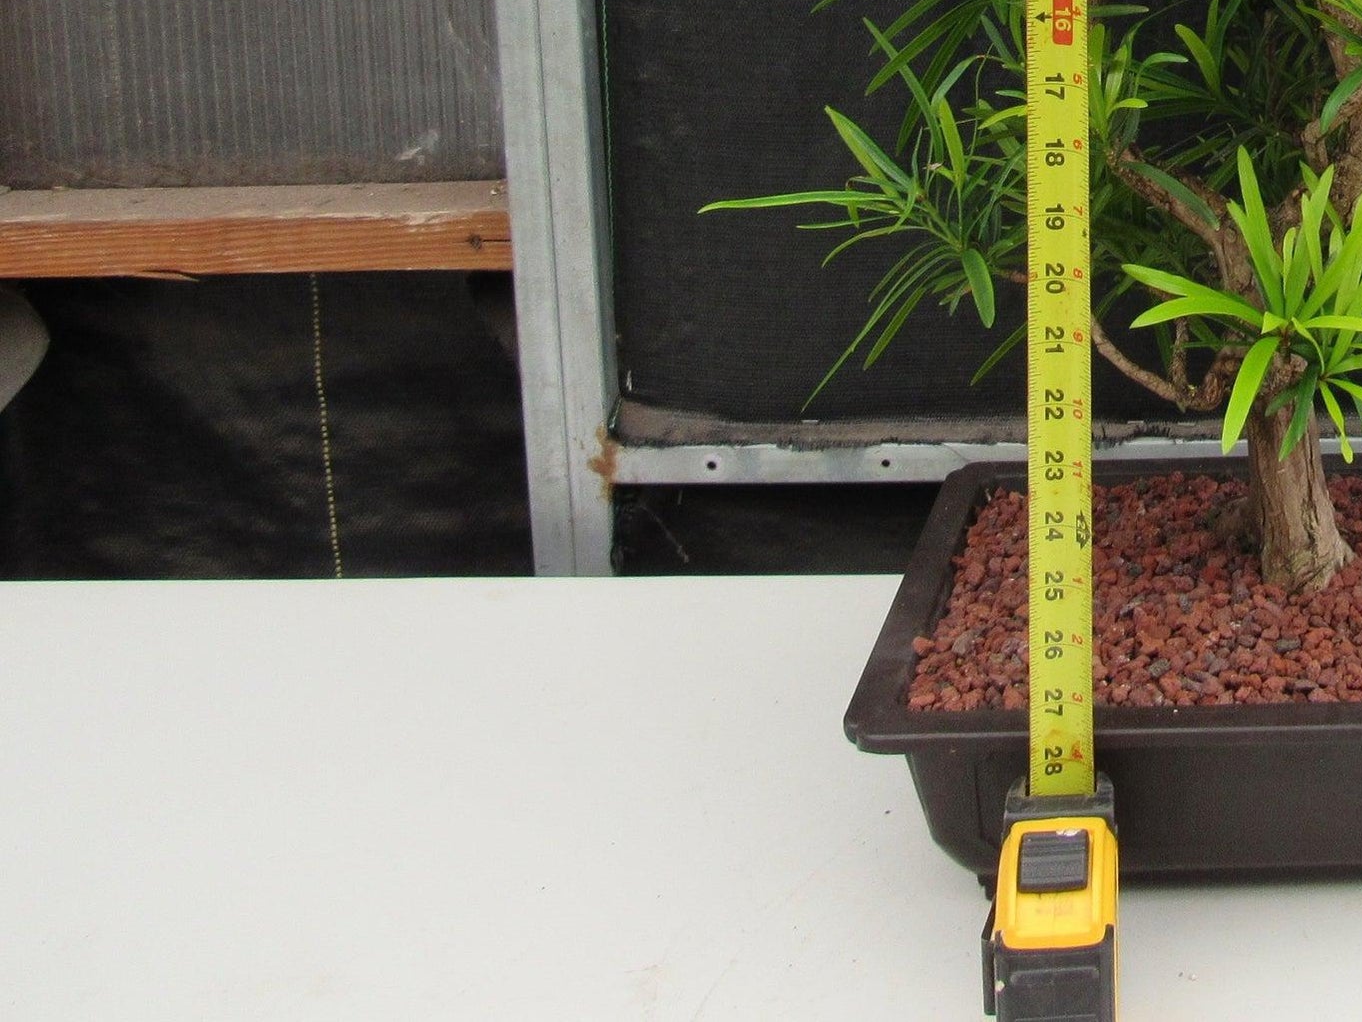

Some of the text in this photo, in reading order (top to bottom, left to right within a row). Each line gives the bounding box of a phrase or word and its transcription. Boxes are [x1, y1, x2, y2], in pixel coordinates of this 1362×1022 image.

[1053, 6, 1071, 33] 16
[1045, 72, 1065, 100] 17
[1073, 73, 1083, 85] 5
[1045, 138, 1065, 167] 18
[1073, 139, 1083, 150] 6
[1045, 204, 1065, 231] 19
[1073, 206, 1083, 216] 7
[1046, 263, 1065, 294] 20
[1073, 268, 1083, 279] 8
[1046, 326, 1065, 353] 21
[1073, 330, 1083, 342] 9
[1046, 389, 1065, 420] 22
[1073, 399, 1083, 419] 10
[1046, 450, 1064, 481] 23
[1073, 461, 1083, 478] 11
[1046, 511, 1064, 542] 24
[1045, 572, 1064, 601] 25
[1045, 630, 1064, 660] 26
[1073, 634, 1083, 645] 2
[1045, 689, 1064, 716] 27
[1073, 692, 1083, 703] 3
[1045, 747, 1063, 776] 28
[1072, 749, 1083, 760] 4
